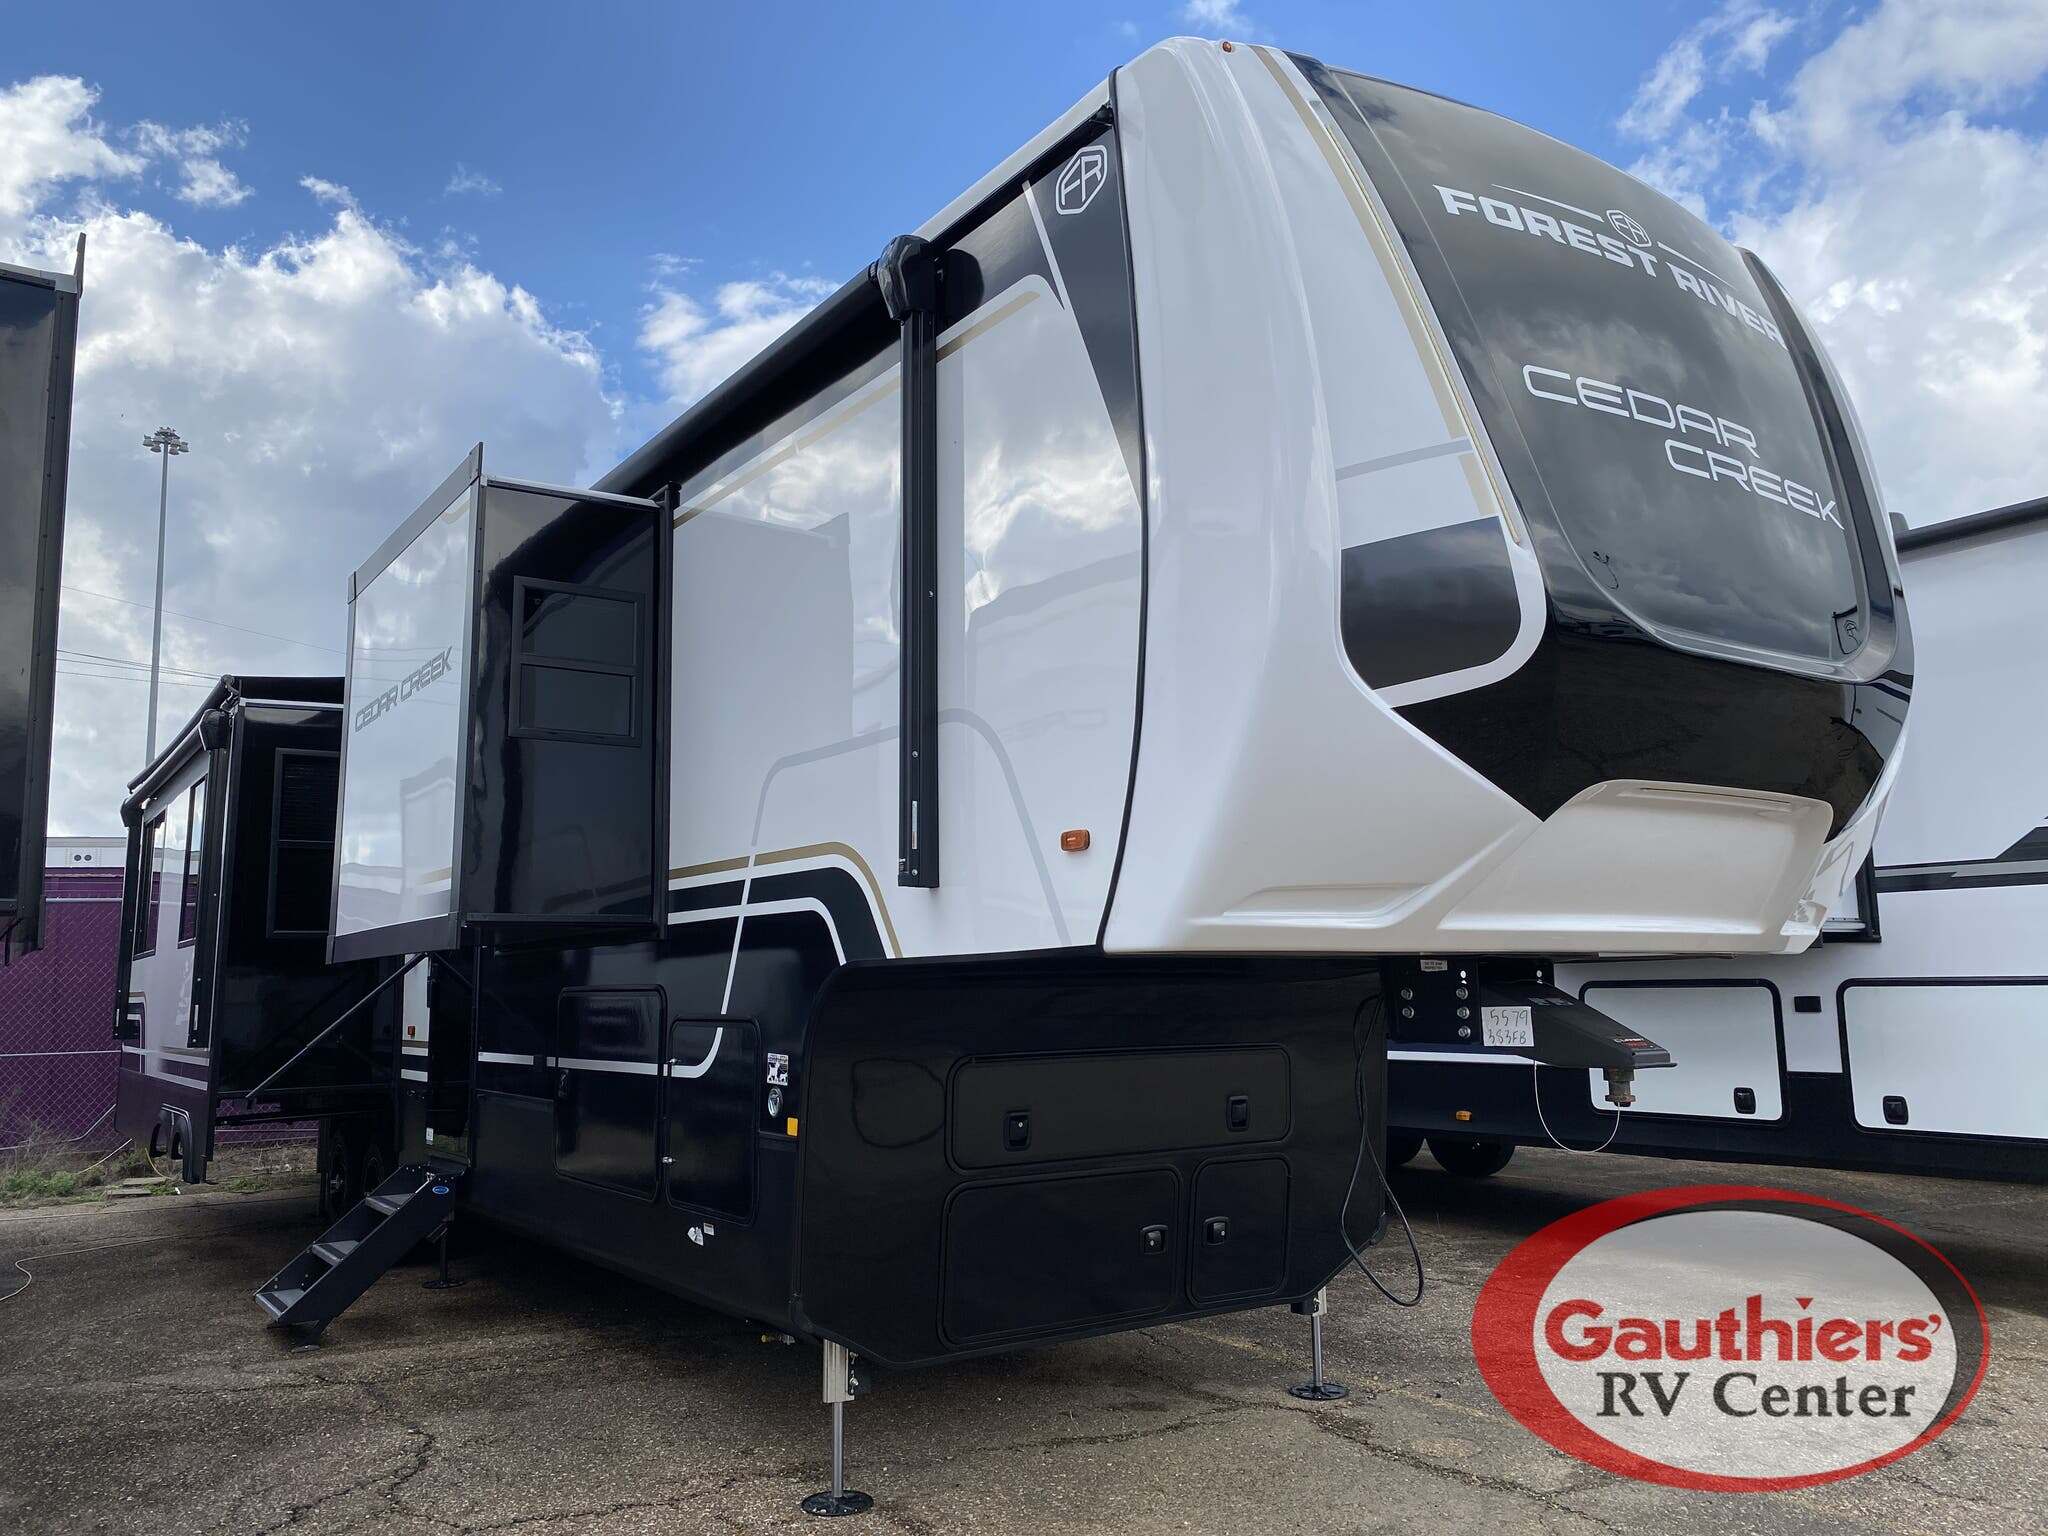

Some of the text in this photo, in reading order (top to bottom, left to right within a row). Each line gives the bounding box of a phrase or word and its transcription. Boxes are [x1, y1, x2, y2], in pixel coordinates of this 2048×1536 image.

[1433, 185, 1789, 350] FOREST RIVER
[1523, 364, 1760, 458] CEDAR
[1665, 439, 1844, 530] CREEK
[355, 646, 452, 732] CEDAR CREEK
[1490, 1008, 1528, 1027] 5579
